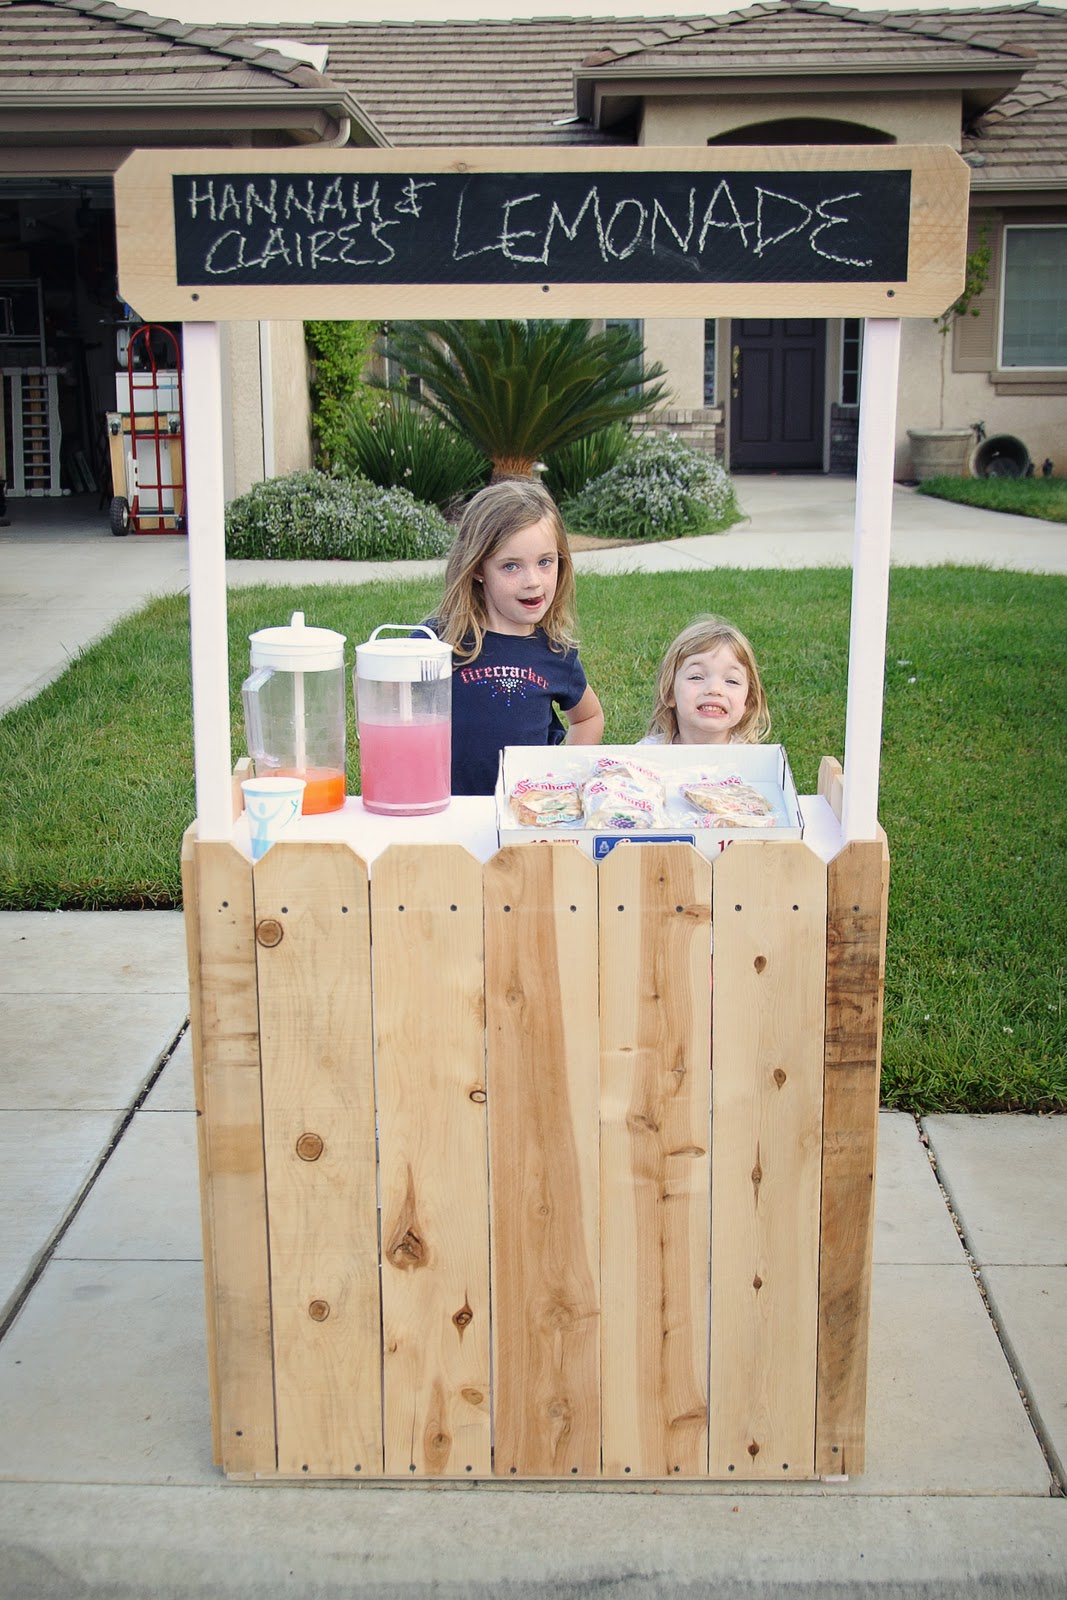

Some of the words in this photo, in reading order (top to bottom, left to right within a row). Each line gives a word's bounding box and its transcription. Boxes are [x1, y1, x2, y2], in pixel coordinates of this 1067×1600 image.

[189, 177, 382, 224] HANNAH
[452, 176, 873, 267] LEMONADE
[204, 220, 400, 274] CLAIRES
[460, 665, 549, 690] firecracker
